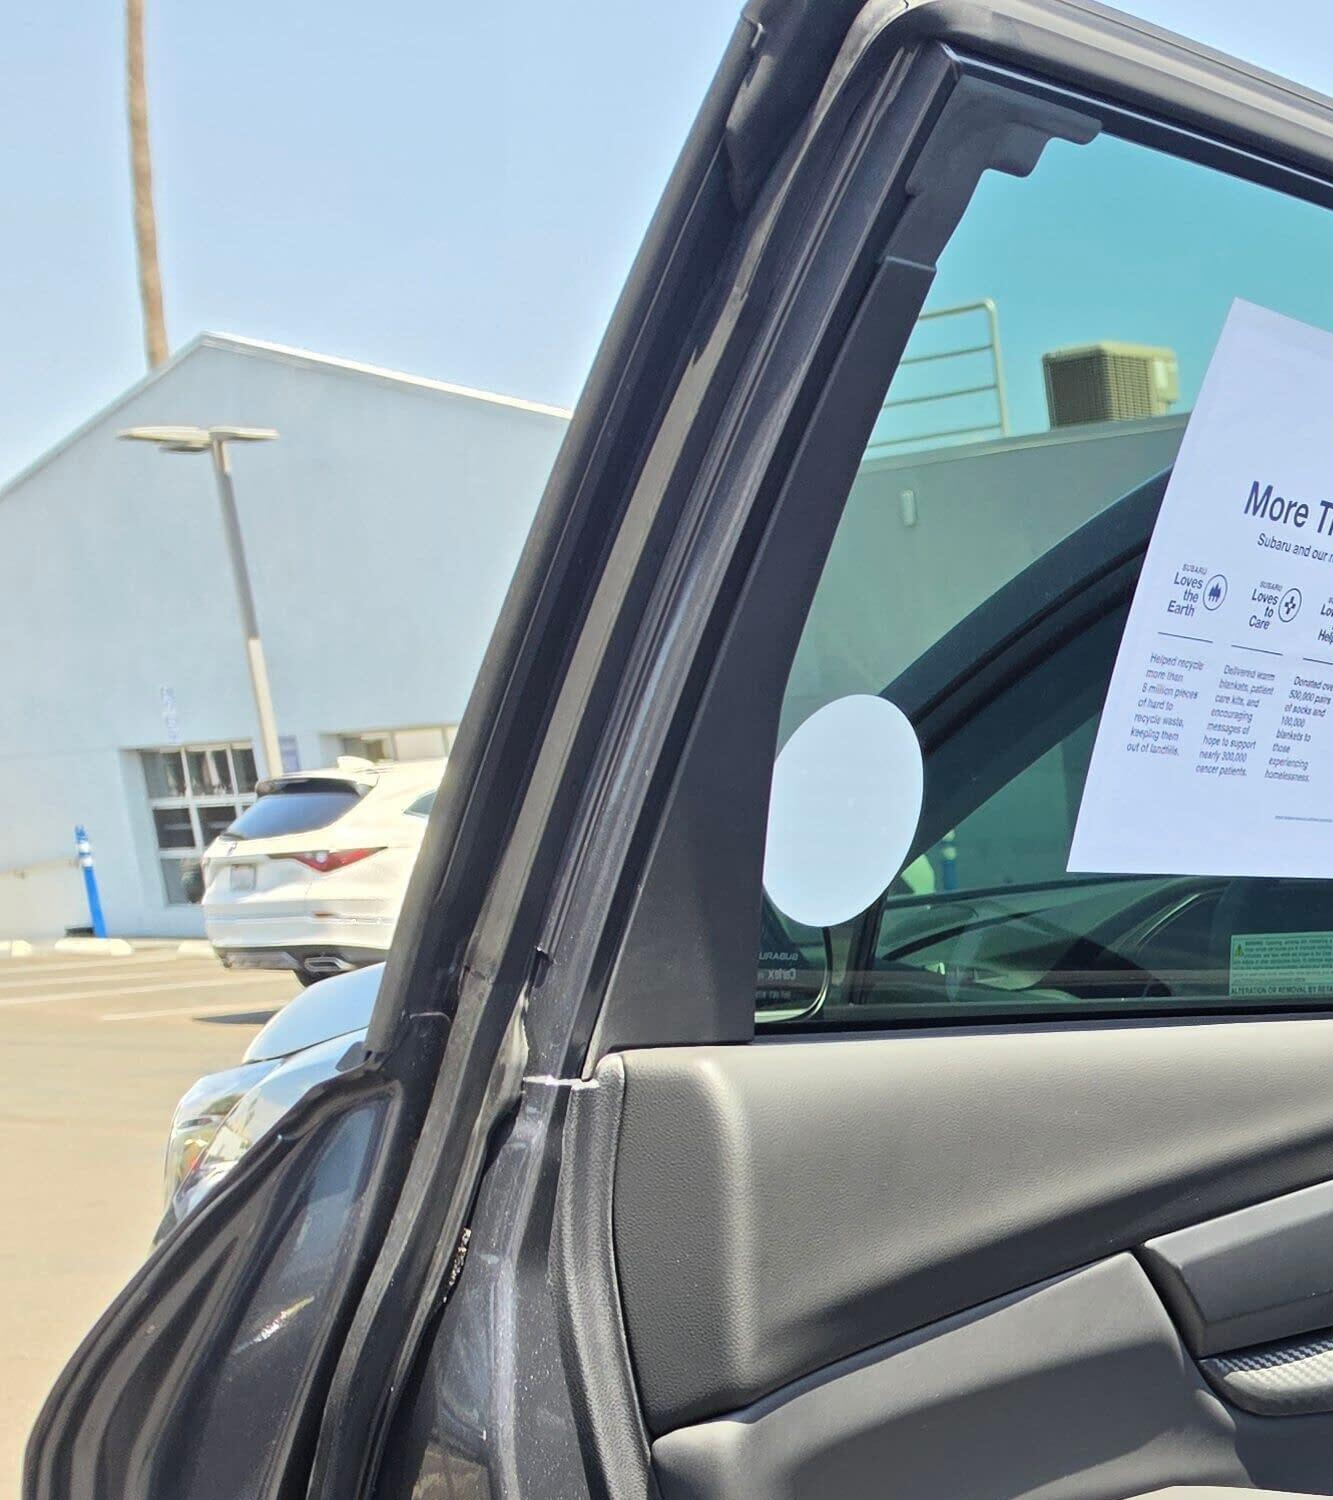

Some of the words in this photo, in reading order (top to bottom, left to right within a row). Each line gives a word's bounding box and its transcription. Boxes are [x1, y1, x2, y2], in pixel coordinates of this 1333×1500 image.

[1244, 480, 1309, 528] More
[1257, 532, 1291, 552] Subaru
[1292, 545, 1311, 557] and
[1311, 550, 1327, 561] our
[1182, 563, 1207, 575] SUBARU
[1174, 572, 1203, 589] Loves
[1183, 588, 1199, 603] the
[1252, 588, 1279, 605] Loves
[1167, 600, 1195, 617] Earth
[1264, 606, 1274, 618] to
[1249, 615, 1270, 629] Care
[1150, 653, 1176, 666] Helped
[1177, 658, 1205, 671] recycle
[1146, 669, 1166, 680] more
[1294, 676, 1322, 690] Donated
[1174, 689, 1198, 700] pieces
[1134, 713, 1161, 725] recycle
[1130, 726, 1160, 741] keeping
[1161, 730, 1179, 741] them
[1126, 743, 1139, 752] out
[1203, 735, 1221, 748] hope
[1230, 739, 1257, 750] support
